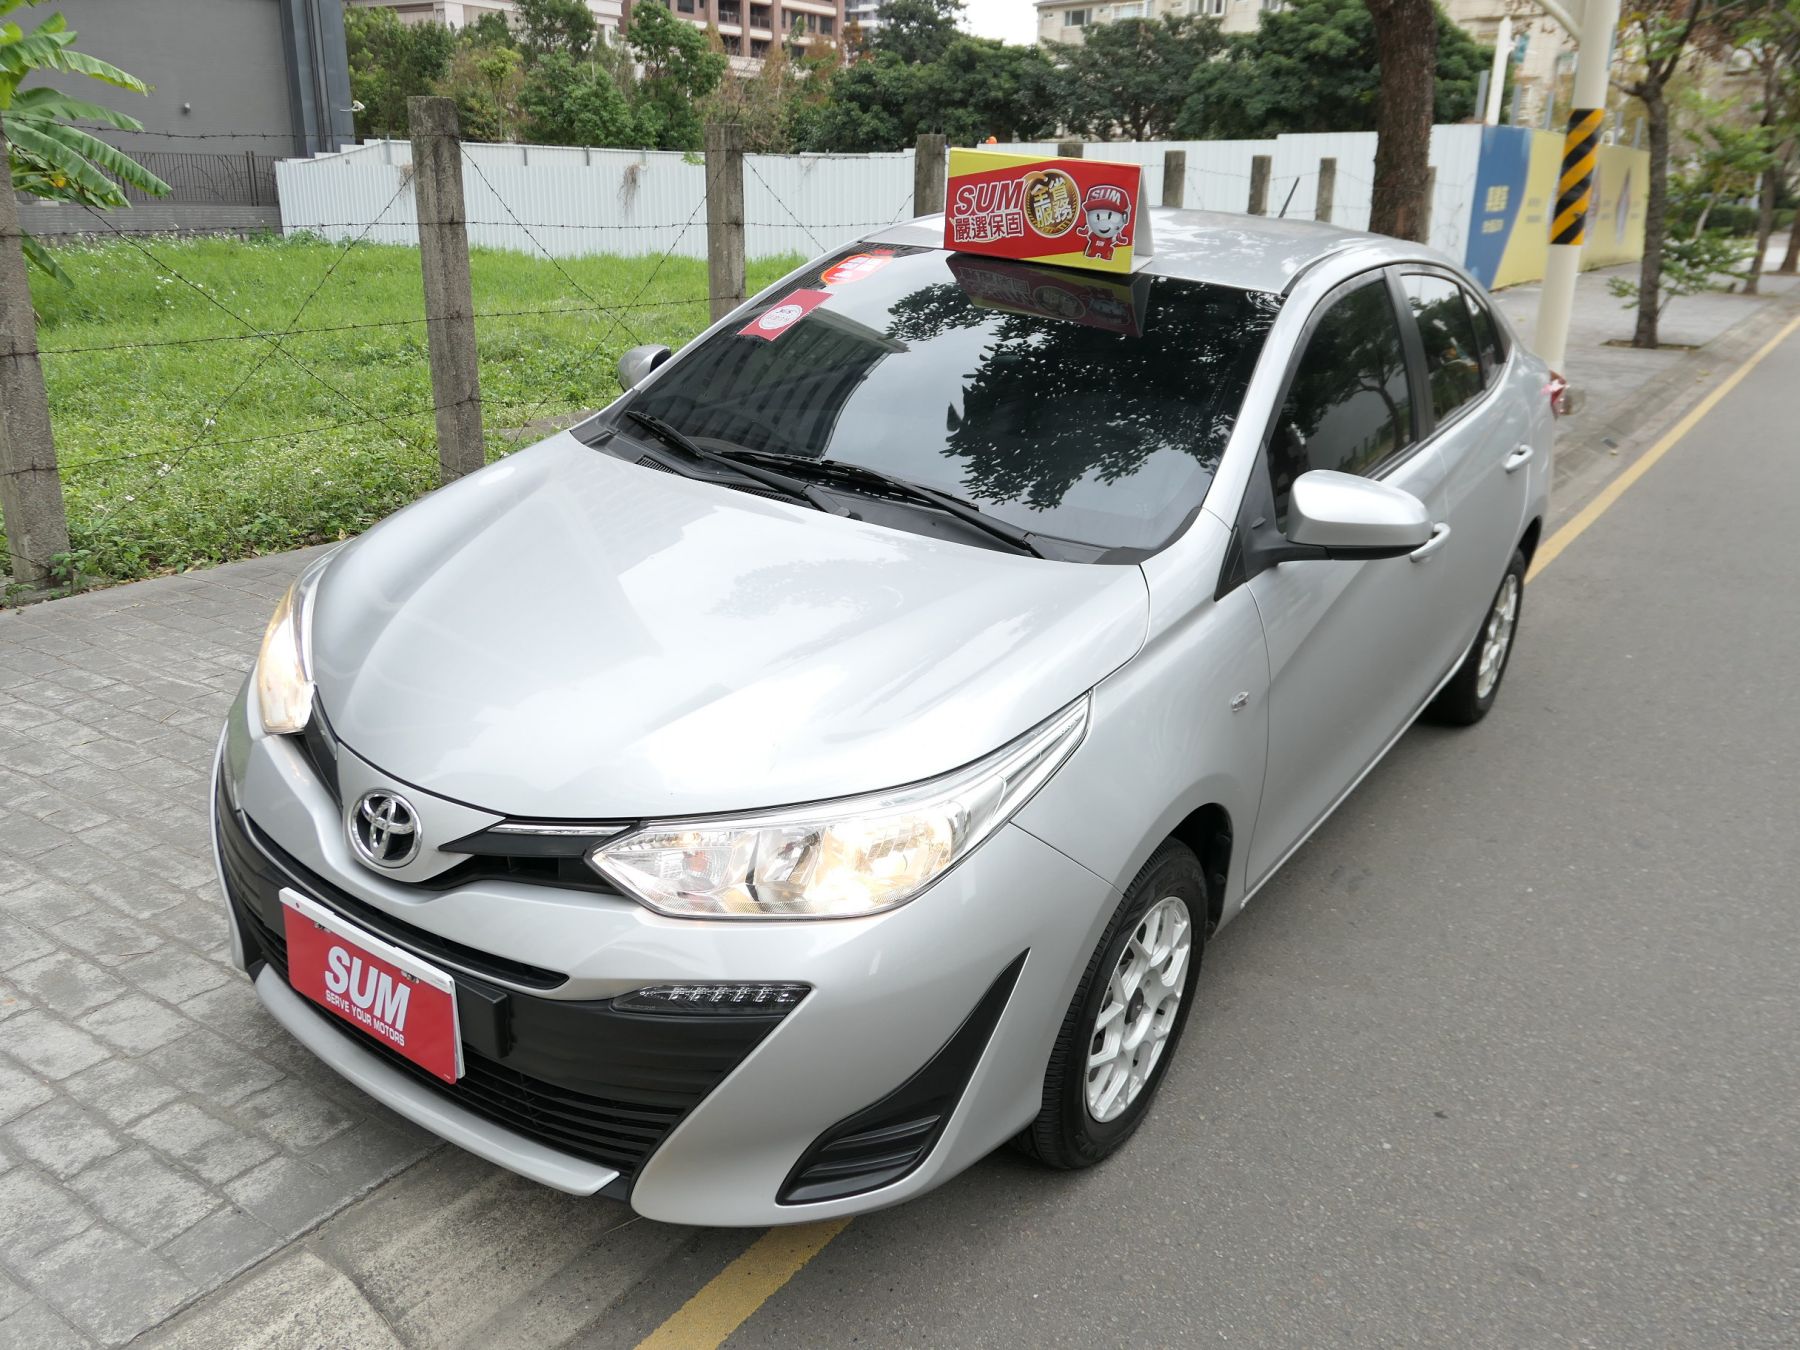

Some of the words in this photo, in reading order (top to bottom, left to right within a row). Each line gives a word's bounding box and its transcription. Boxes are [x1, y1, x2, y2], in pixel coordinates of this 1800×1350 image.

[954, 180, 1025, 217] SUM
[1091, 188, 1121, 205] SUM
[954, 211, 1024, 242] 嚴選保固
[325, 946, 411, 1031] SUM
[325, 990, 350, 1012] SERVE
[351, 1005, 372, 1026] YOUR
[373, 1018, 405, 1047] MOTORS
